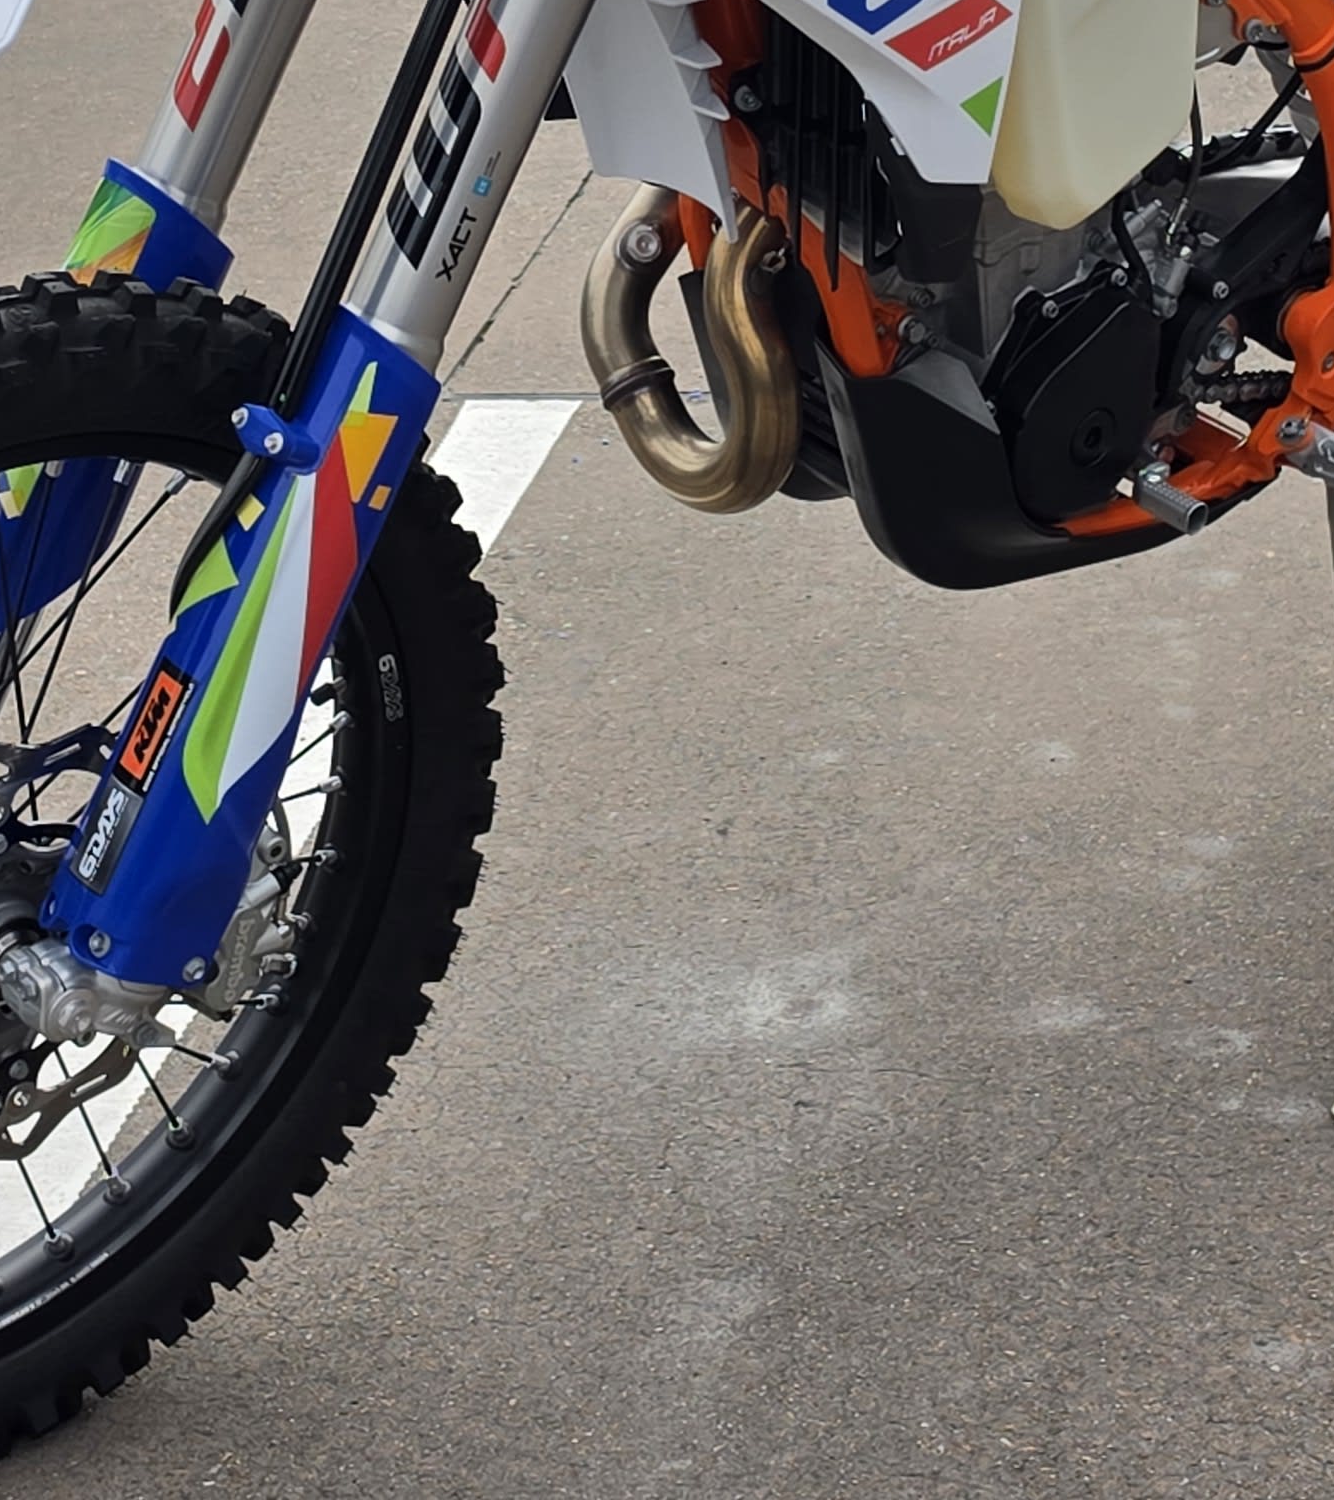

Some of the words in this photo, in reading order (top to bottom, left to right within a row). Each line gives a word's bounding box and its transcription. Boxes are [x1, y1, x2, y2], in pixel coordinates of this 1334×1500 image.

[434, 206, 478, 282] XACT
[133, 686, 172, 764] KTM
[78, 787, 126, 879] 6DAYS
[225, 918, 256, 1002] brembo
